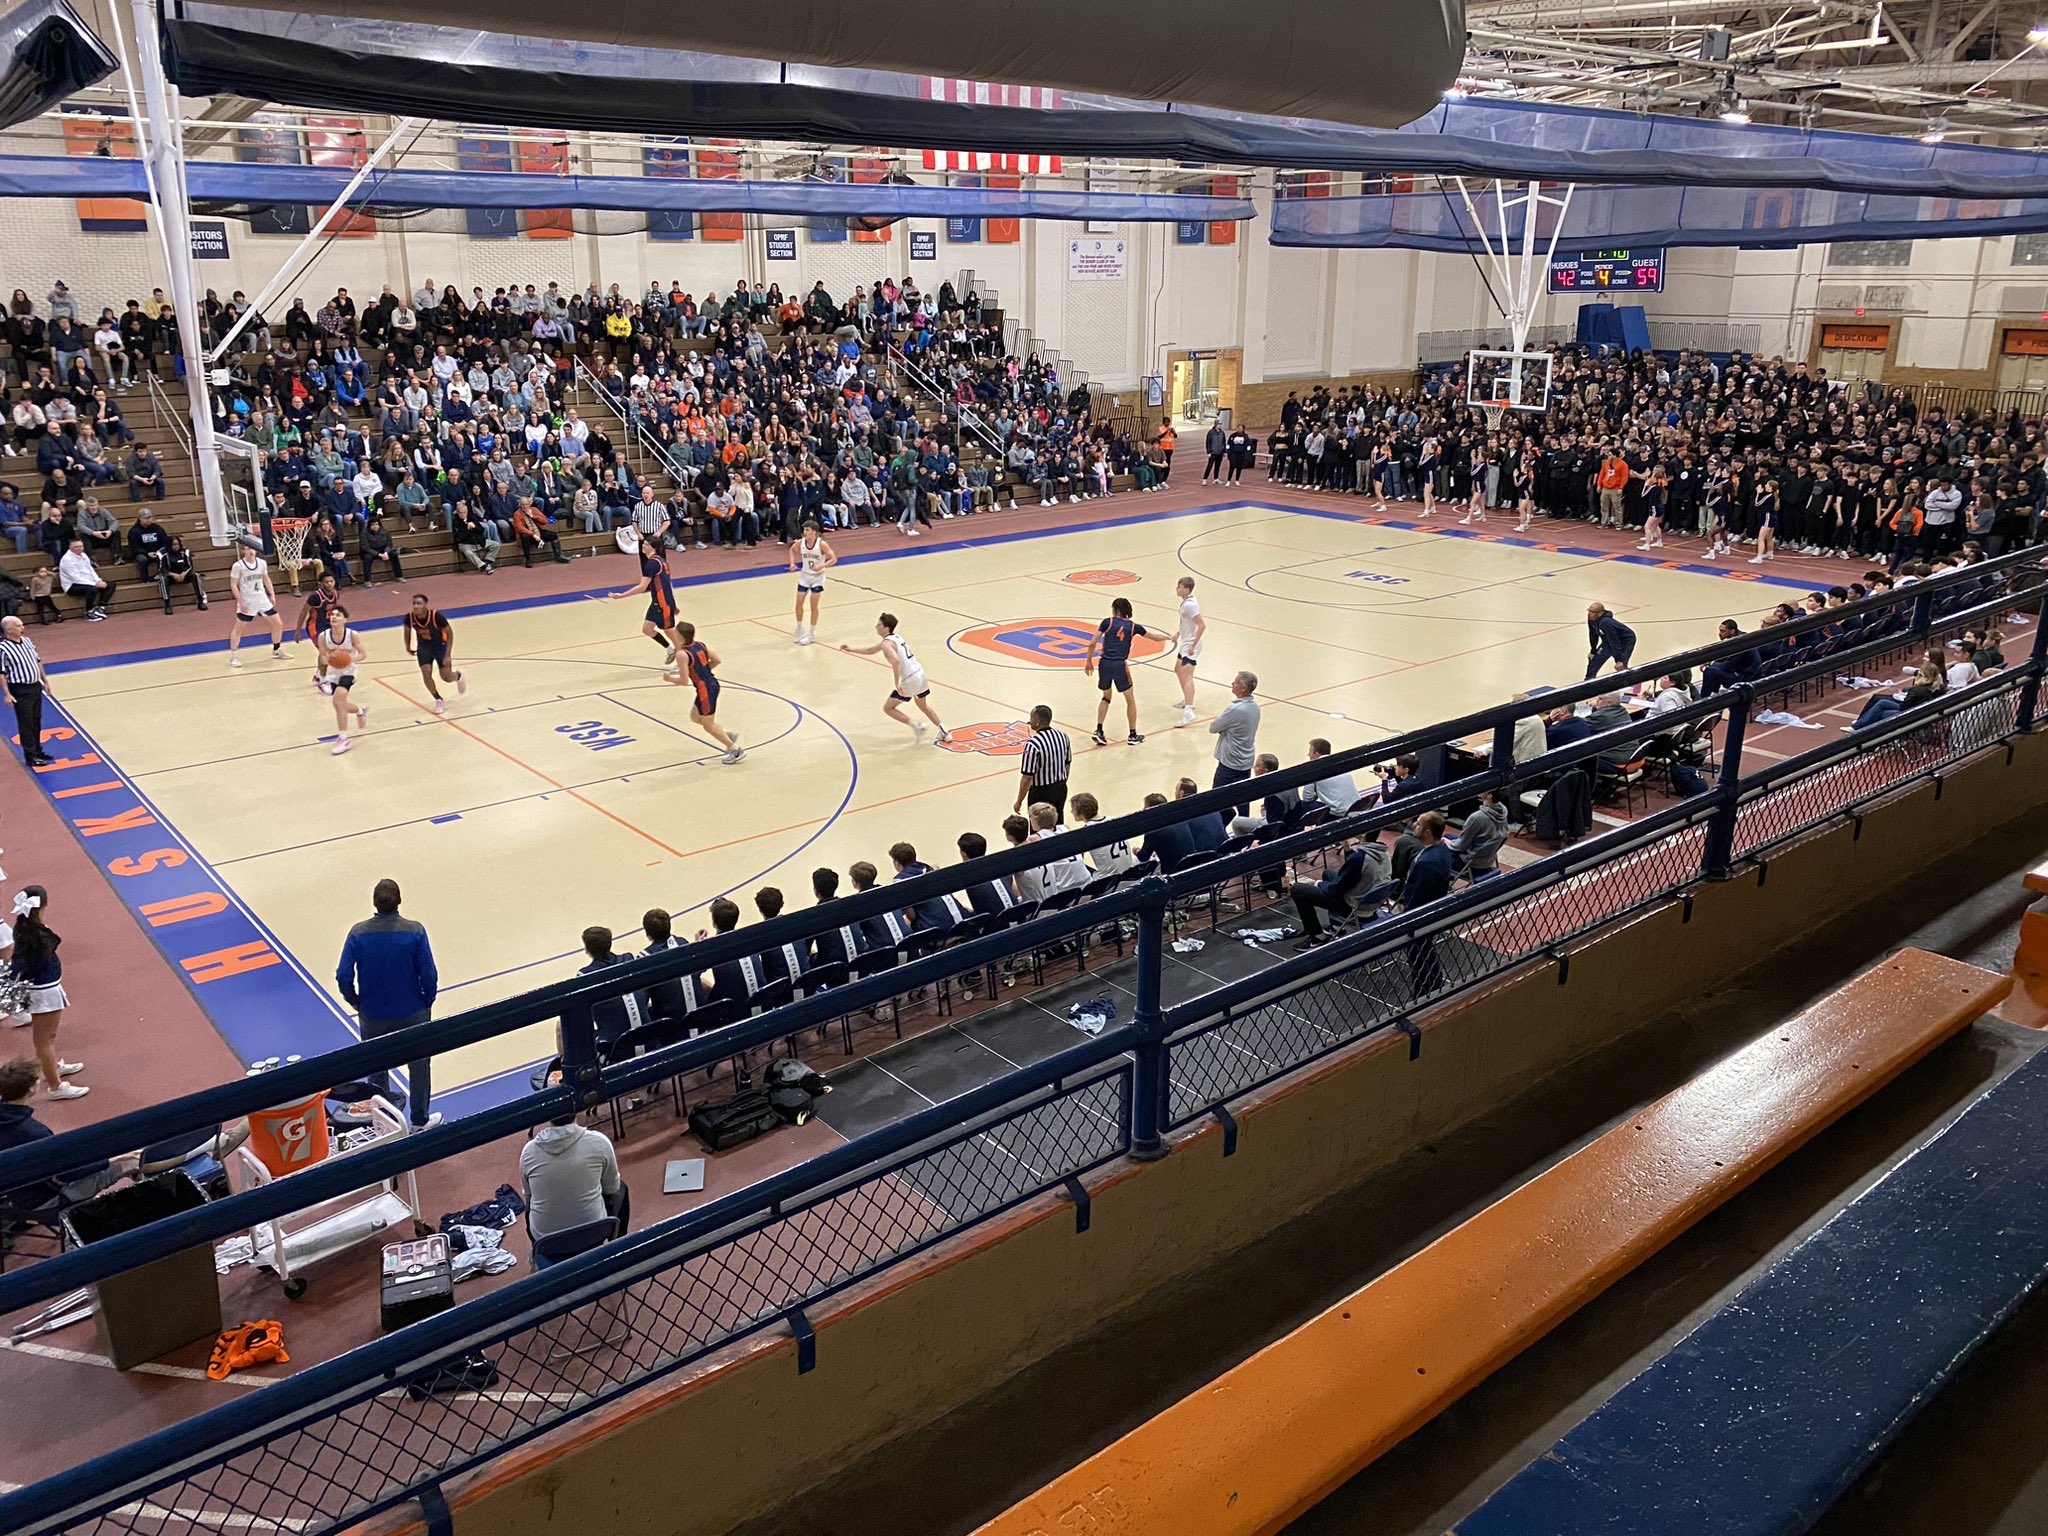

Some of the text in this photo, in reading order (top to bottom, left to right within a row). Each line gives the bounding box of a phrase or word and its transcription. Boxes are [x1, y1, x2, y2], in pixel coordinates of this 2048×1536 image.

[190, 231, 223, 240] SITORS
[769, 241, 793, 249] STUDENT
[1632, 259, 1659, 267] GUEST
[1557, 270, 1575, 286] 42
[1599, 270, 1608, 286] 4
[1637, 268, 1657, 285] 59
[1834, 332, 1878, 342] DEDICATION
[1355, 517, 1763, 581] HUSKIES
[1343, 571, 1410, 585] WSC
[1116, 626, 1125, 642] 4
[554, 720, 637, 751] WSC
[11, 726, 283, 985] HUSKIES
[282, 1116, 306, 1142] G
